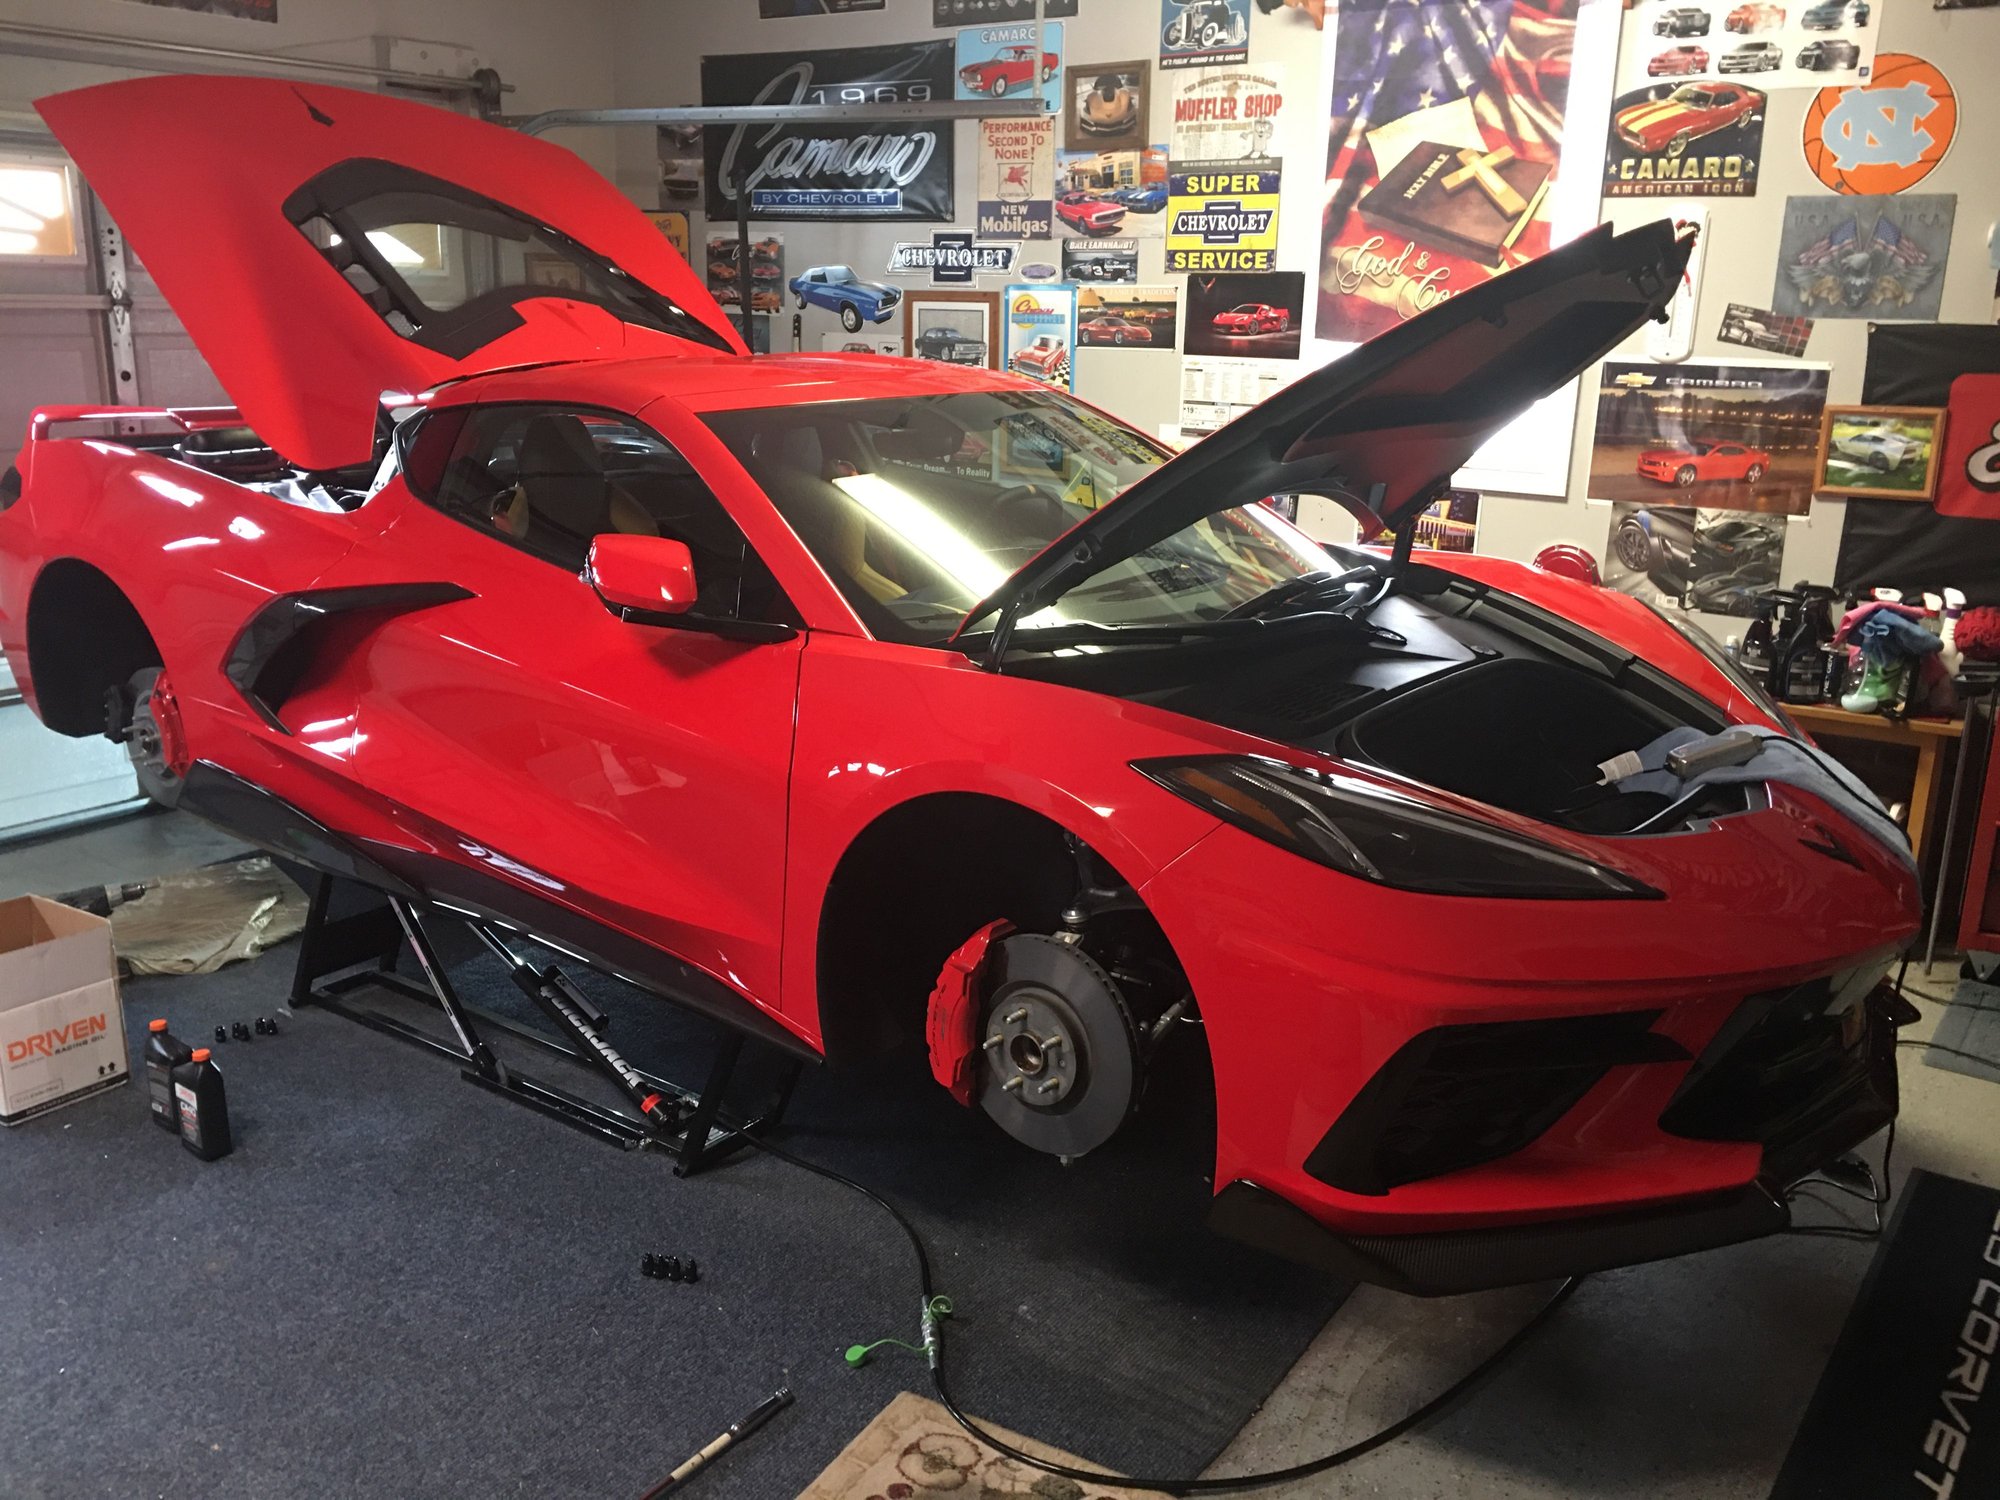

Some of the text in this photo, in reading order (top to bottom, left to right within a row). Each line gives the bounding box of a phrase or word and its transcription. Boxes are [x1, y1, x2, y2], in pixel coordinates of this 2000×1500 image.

[811, 85, 931, 105] 1969
[1175, 94, 1282, 122] MUFFLER SHOP
[718, 62, 936, 200] Camaro
[983, 121, 1052, 134] PERFORMANCE
[995, 147, 1035, 160] NONE!
[1620, 156, 1742, 179] CAMARO
[1186, 175, 1260, 193] SUPER
[1404, 176, 1425, 200] HOLY
[1612, 183, 1744, 194] AMERICAN ICON
[762, 193, 888, 204] BY CHEVROLET
[1001, 205, 1028, 215] NEW
[981, 217, 1048, 238] Mobilgas
[1177, 214, 1268, 232] CHEVROLET
[901, 248, 1007, 268] CHEVROLET
[1174, 251, 1268, 269] SERVICE
[1336, 236, 1430, 294] God &
[1092, 265, 1103, 276] 3
[957, 466, 965, 475] To
[966, 467, 990, 478] Reality
[7, 1013, 107, 1063] DRIVEN
